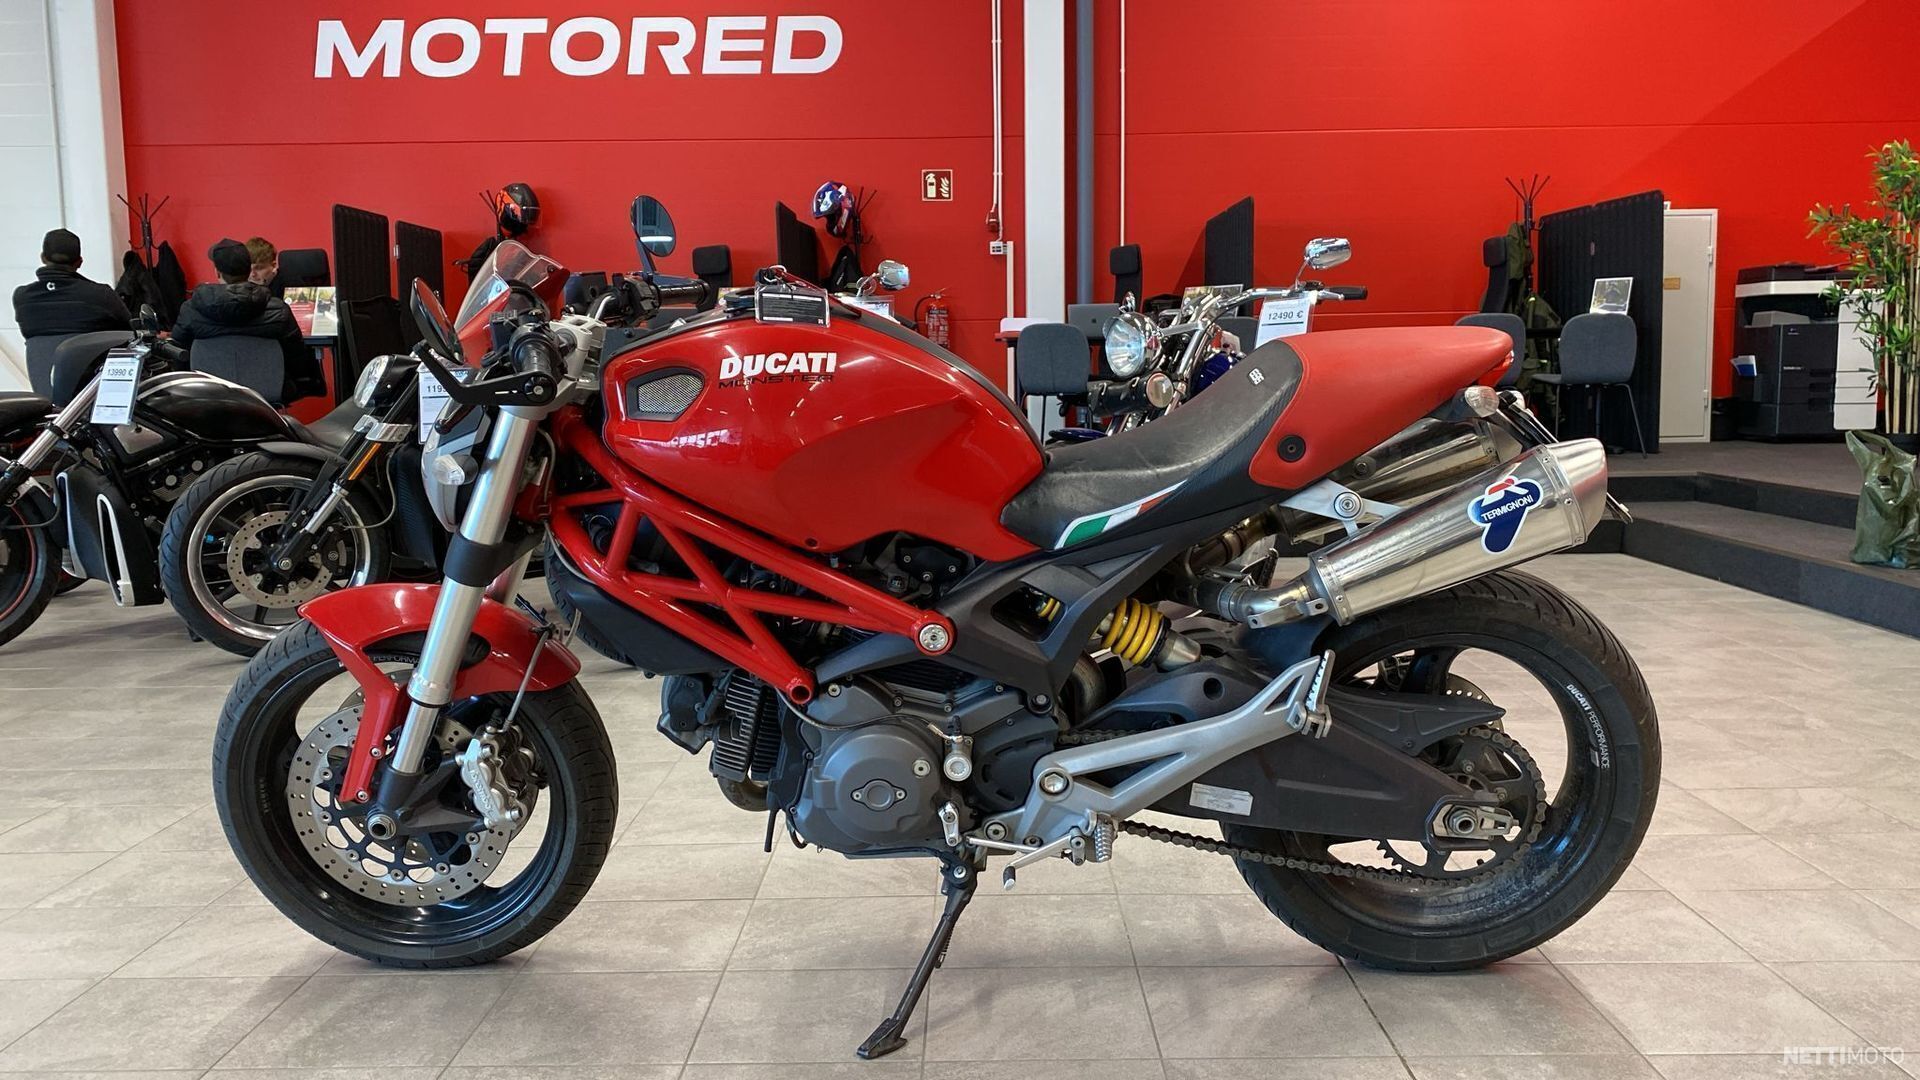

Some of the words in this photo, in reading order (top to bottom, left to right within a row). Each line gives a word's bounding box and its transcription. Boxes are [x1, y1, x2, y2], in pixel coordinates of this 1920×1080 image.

[314, 15, 844, 79] MOTORED
[1268, 311, 1294, 321] 12490
[1296, 310, 1304, 319] €
[107, 368, 127, 376] 13990
[719, 352, 838, 380] DUCATI
[426, 384, 448, 393] 119
[1481, 494, 1535, 521] TERMIGNONI
[1566, 684, 1592, 711] DUCATI
[1588, 710, 1610, 769] PERFORMANCE
